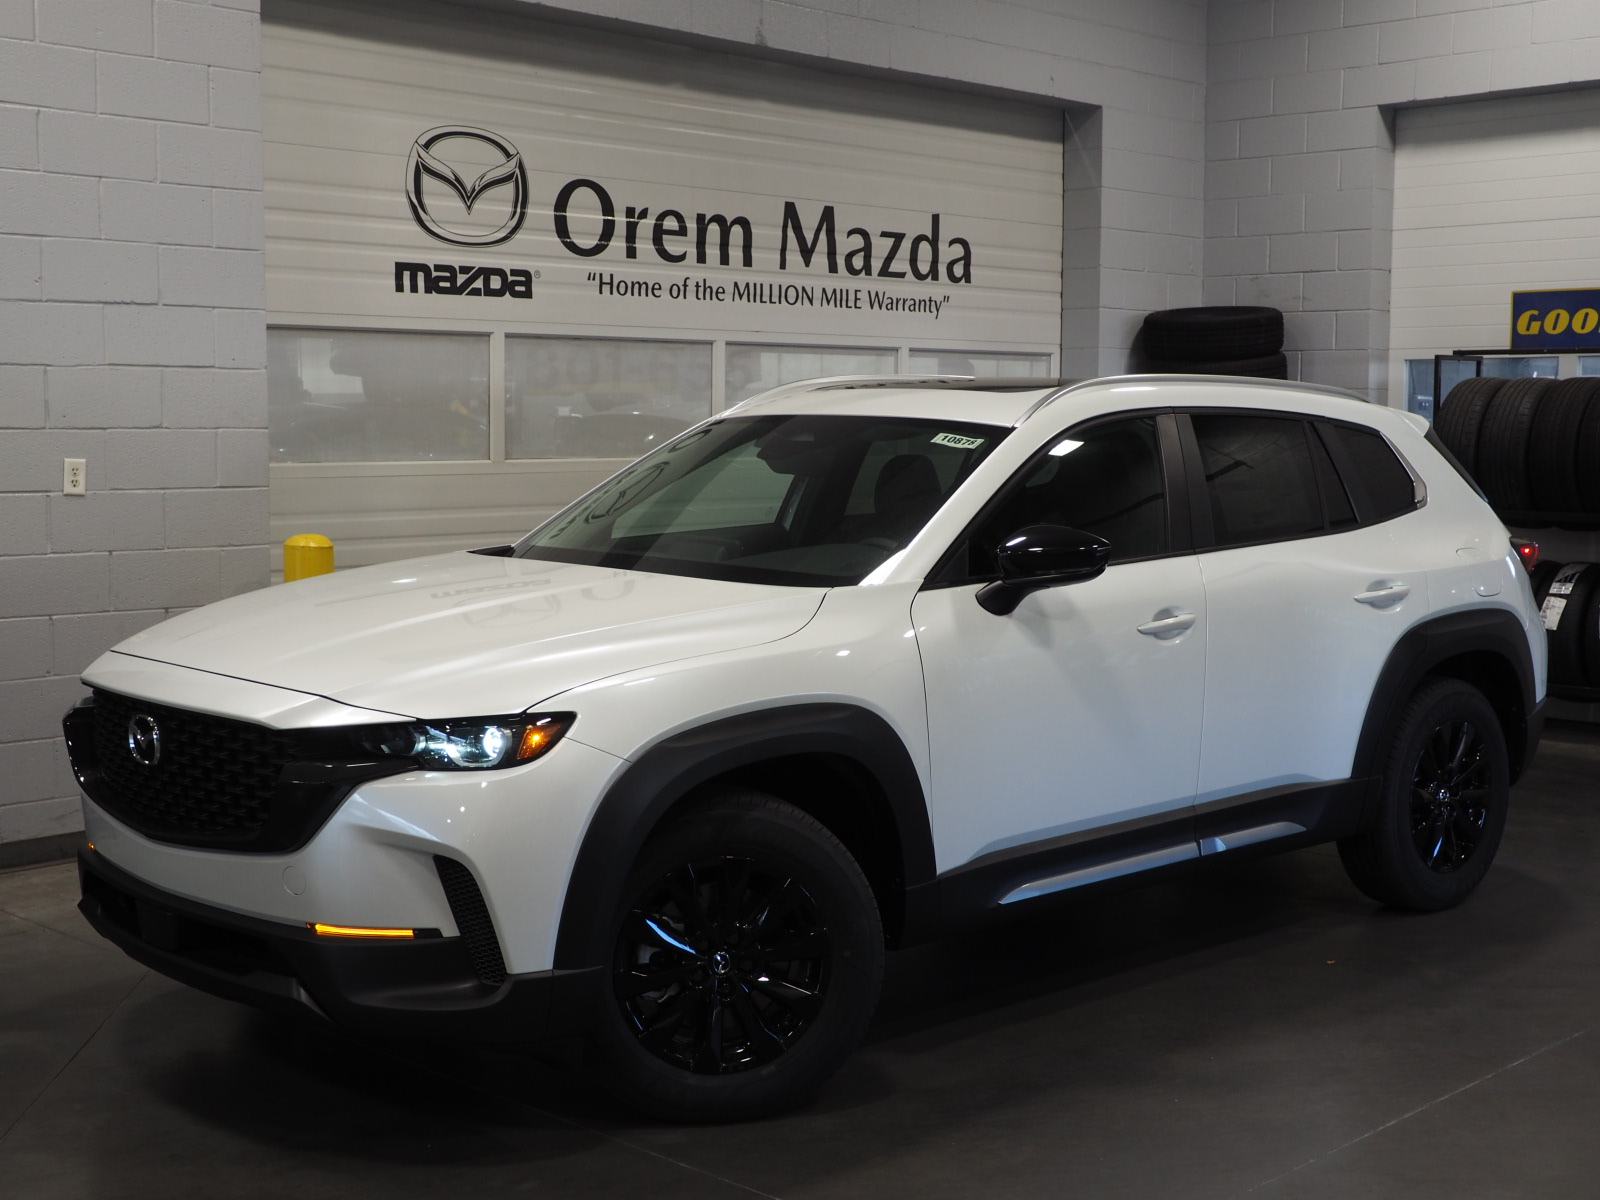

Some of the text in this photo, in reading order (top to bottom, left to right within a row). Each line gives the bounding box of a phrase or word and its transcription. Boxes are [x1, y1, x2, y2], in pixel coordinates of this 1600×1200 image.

[554, 178, 972, 284] Orem Mazda
[587, 272, 950, 319] “Home of the MILLION MILE Warranty”
